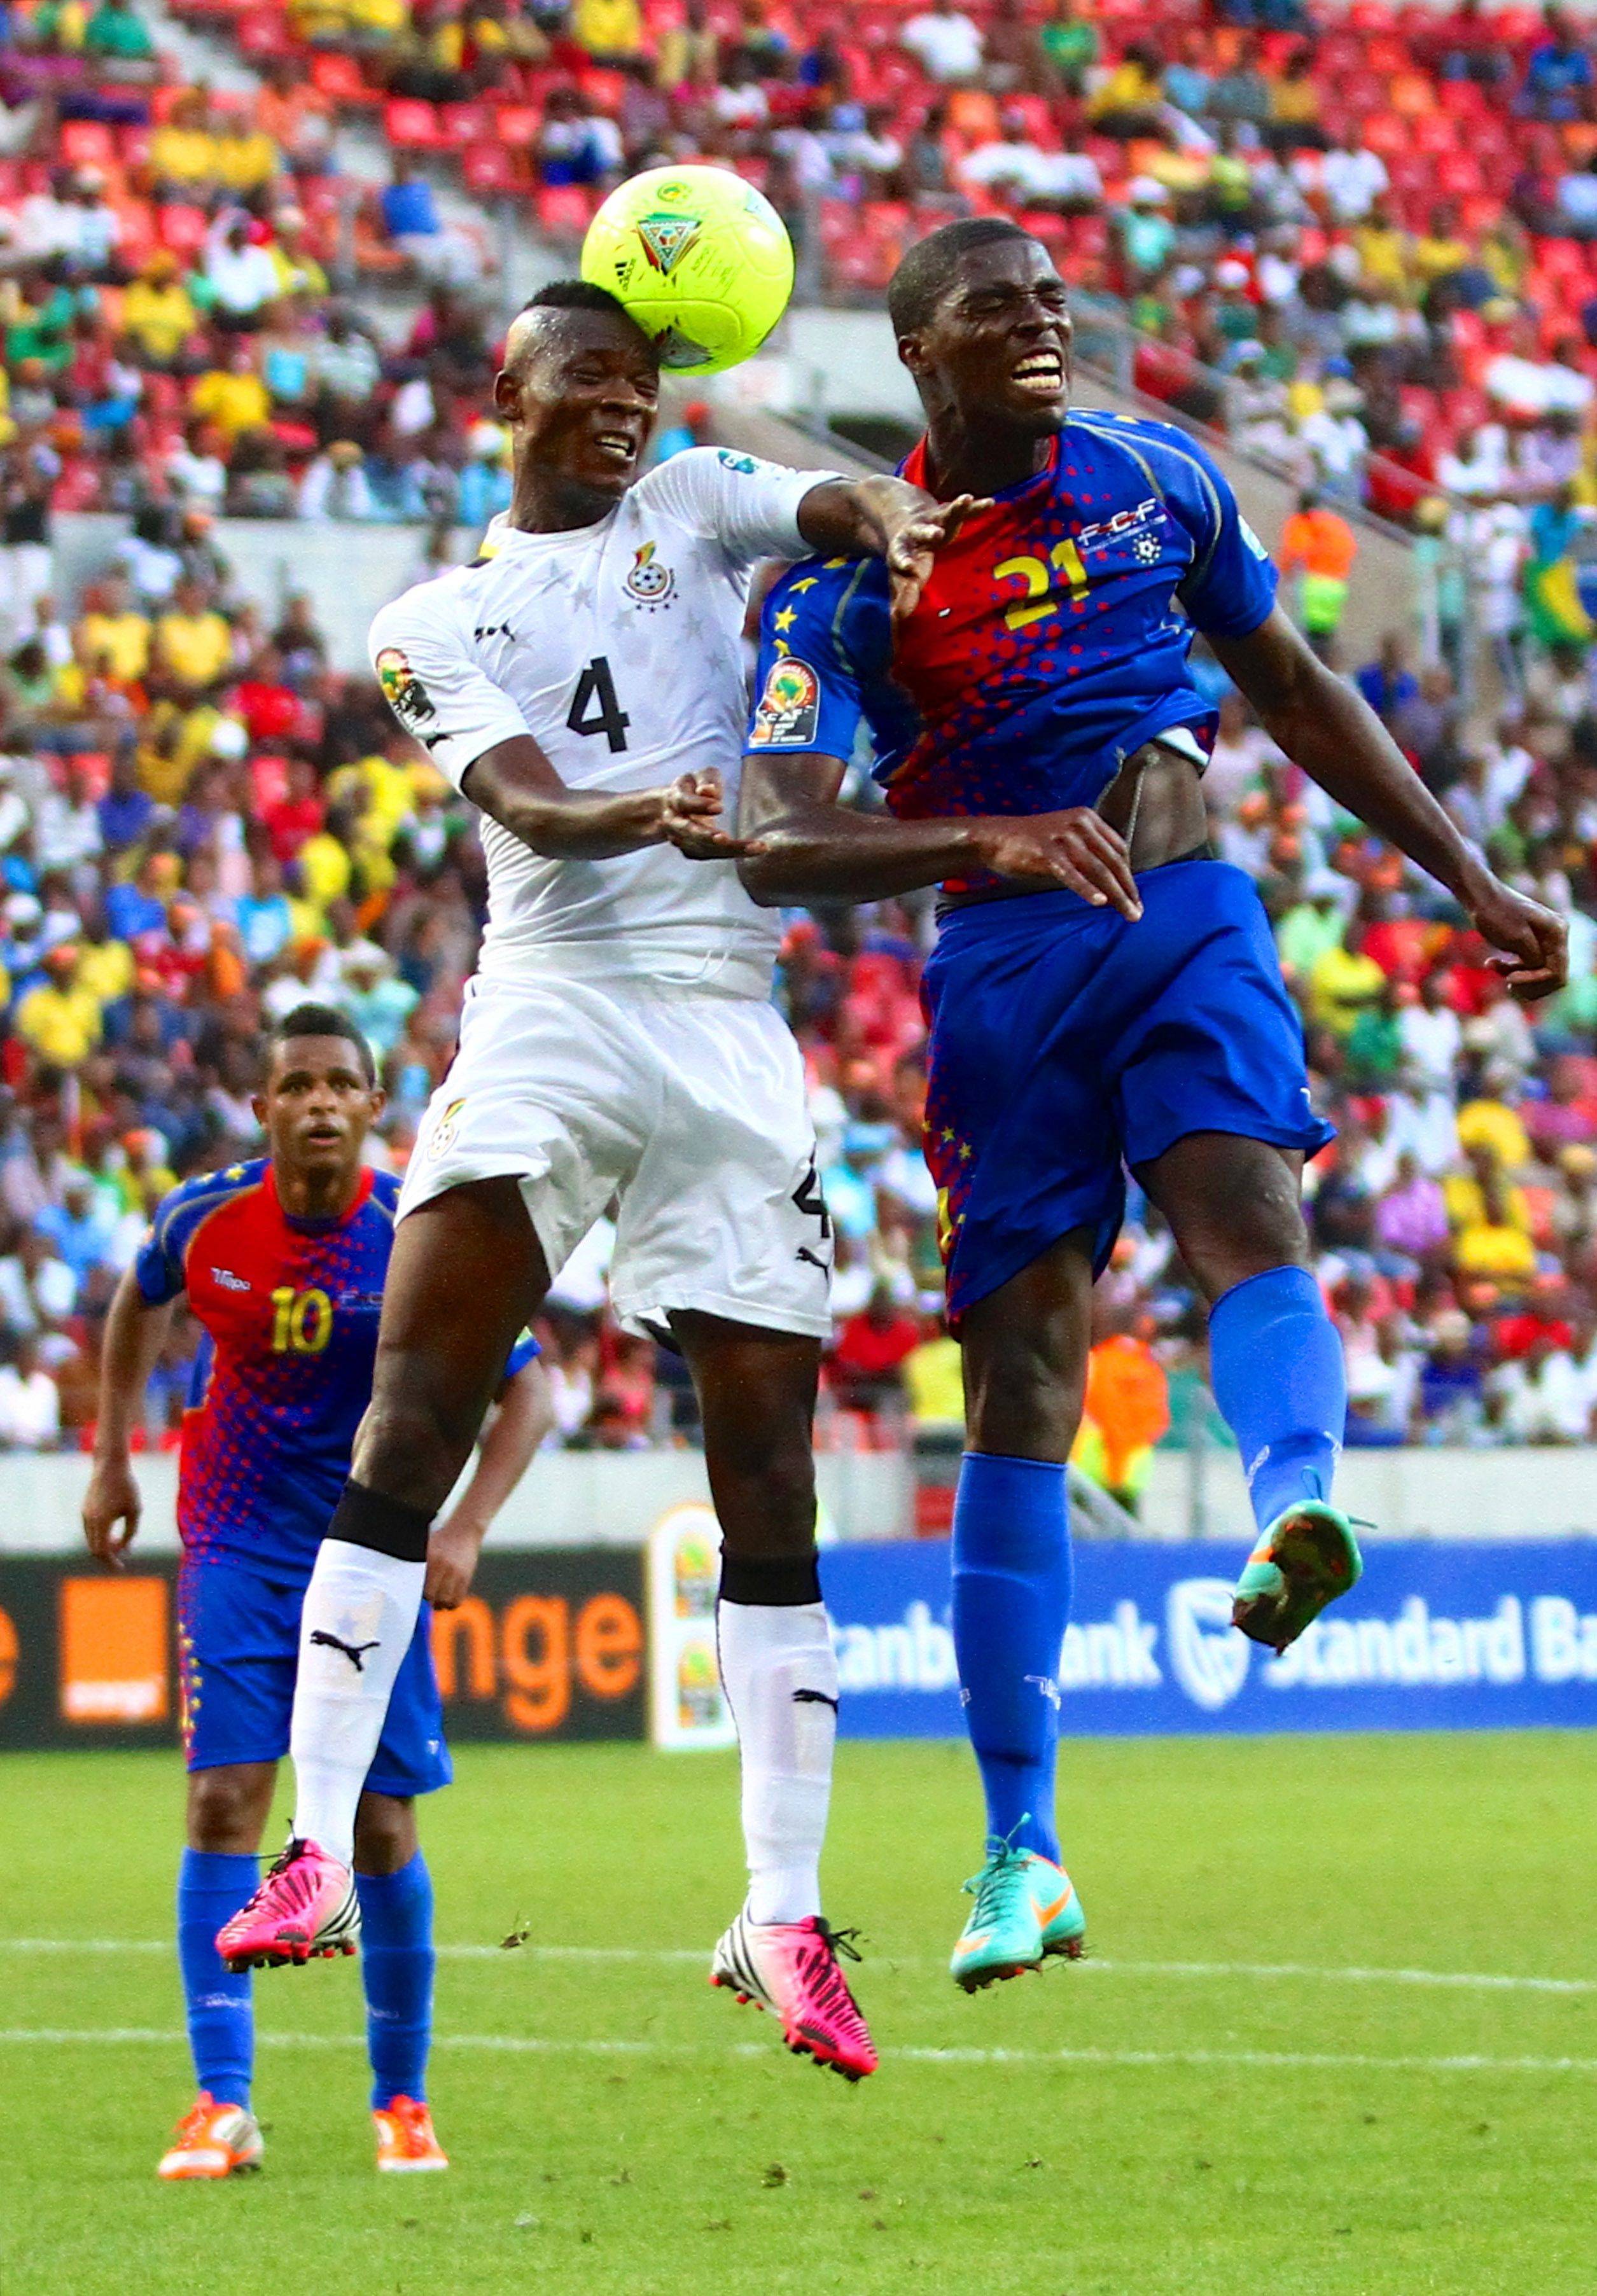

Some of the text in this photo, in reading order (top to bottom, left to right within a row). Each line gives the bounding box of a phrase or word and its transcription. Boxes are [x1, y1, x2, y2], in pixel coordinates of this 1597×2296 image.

[993, 538, 1091, 631] 21
[566, 656, 631, 753] 4
[270, 1286, 333, 1354] 10
[430, 1592, 641, 1730] nge
[1059, 1600, 1163, 1688] ank
